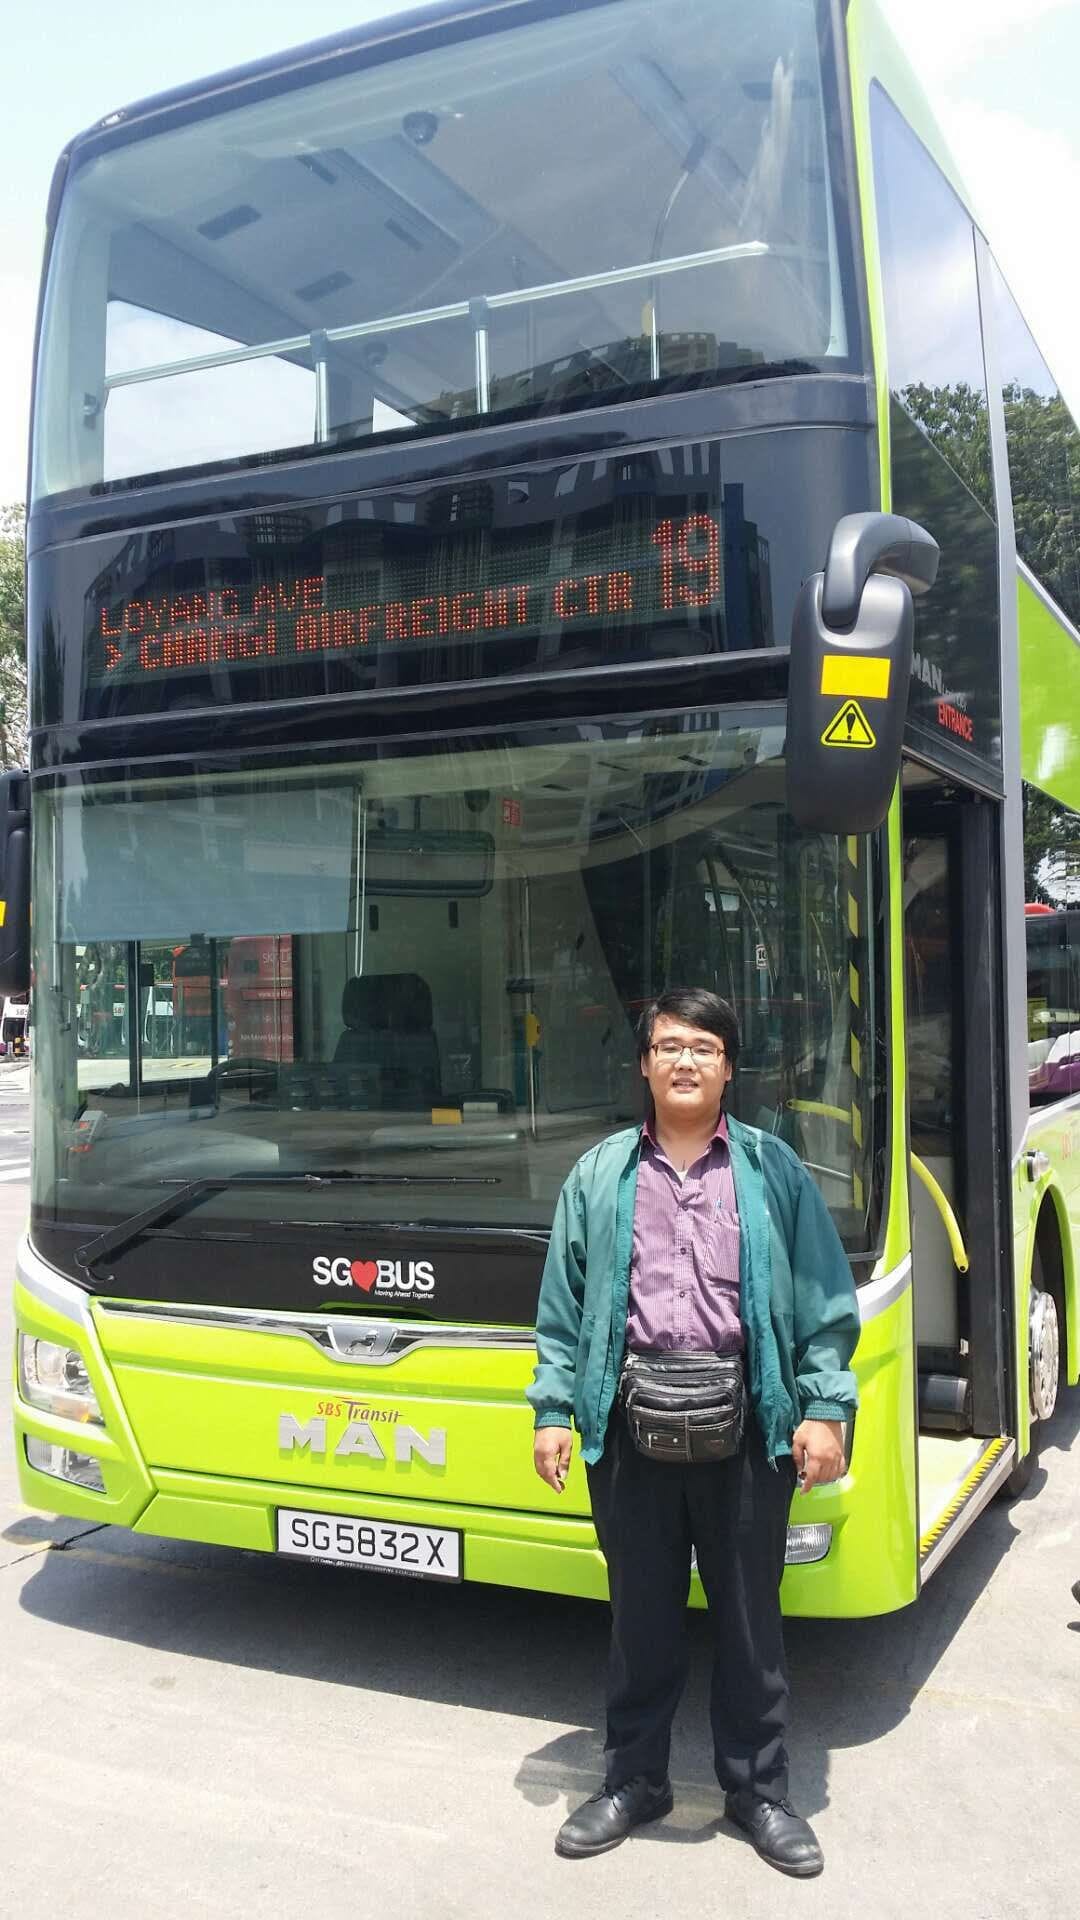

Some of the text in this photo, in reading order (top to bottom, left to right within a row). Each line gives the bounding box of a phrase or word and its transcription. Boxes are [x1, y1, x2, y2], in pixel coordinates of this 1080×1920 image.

[651, 513, 720, 609] 19
[101, 576, 325, 637] LOYANG AVE
[140, 571, 632, 670] CHANGI AIRFREIGHT CTR
[910, 650, 942, 694] MAN
[937, 701, 974, 742] ENTRANCE
[374, 1289, 434, 1299] Moving Ahead Together
[316, 1400, 404, 1423] SBS Transit
[279, 1414, 446, 1466] MAN
[291, 1518, 445, 1567] SG5832X
